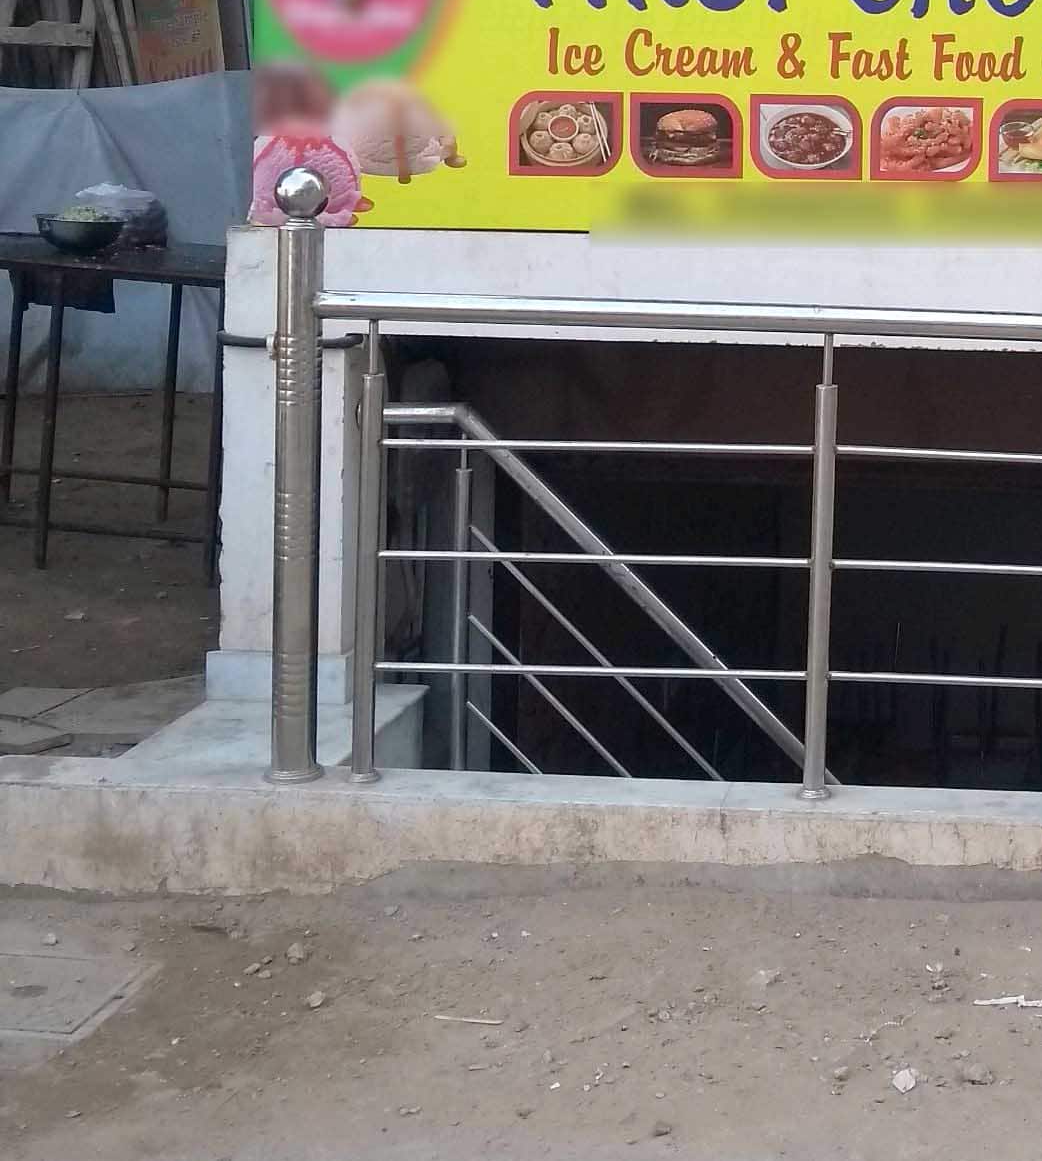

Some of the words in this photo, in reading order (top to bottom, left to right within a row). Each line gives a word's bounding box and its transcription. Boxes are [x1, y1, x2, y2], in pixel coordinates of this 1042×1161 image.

[547, 27, 606, 76] Ice
[624, 28, 758, 79] Cream
[777, 32, 806, 79] &
[828, 32, 914, 81] Fast
[931, 33, 1027, 83] Food
